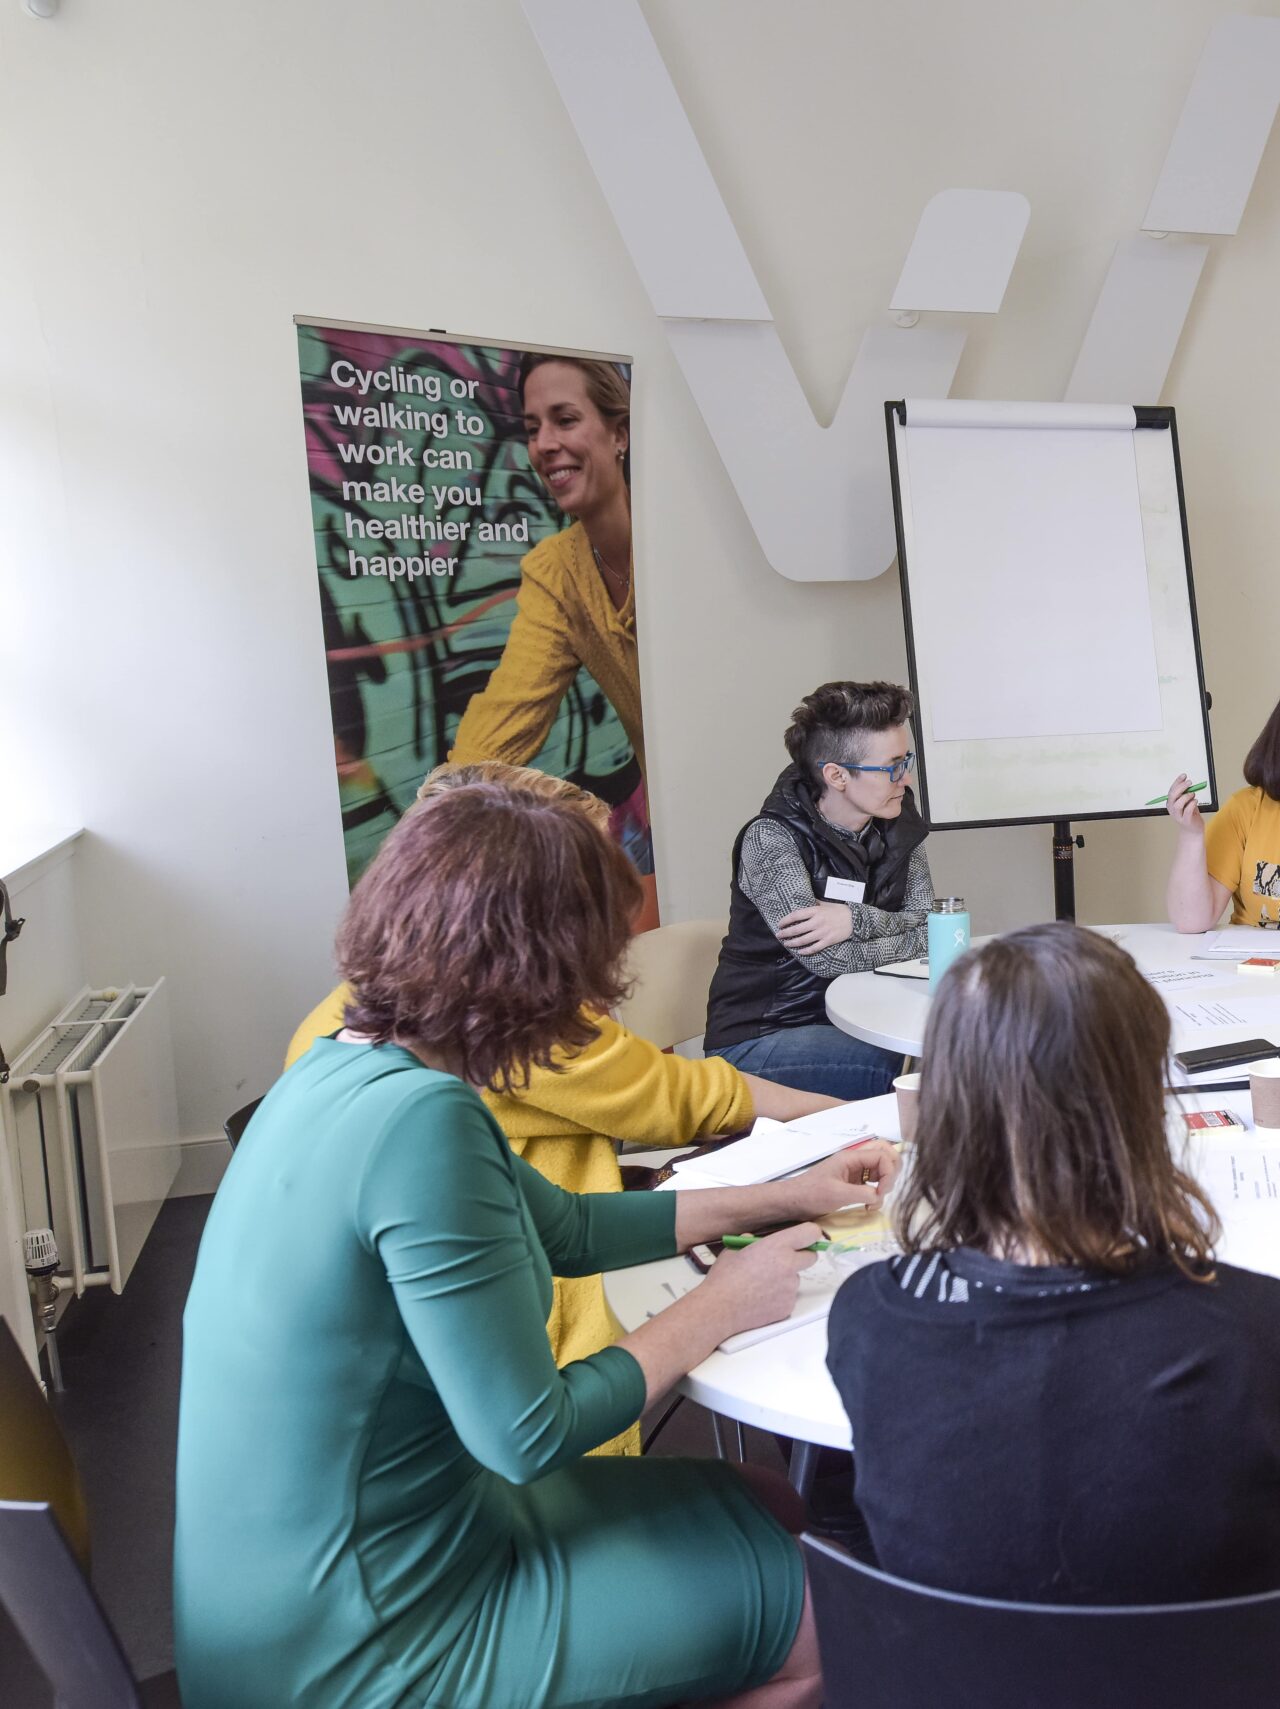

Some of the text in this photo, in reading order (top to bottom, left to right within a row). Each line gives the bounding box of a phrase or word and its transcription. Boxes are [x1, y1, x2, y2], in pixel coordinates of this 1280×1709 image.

[330, 359, 479, 401] Cycling or
[334, 402, 484, 439] walking to
[338, 440, 473, 470] work can
[342, 477, 482, 510] make you
[345, 512, 529, 543] healthier and
[348, 550, 459, 582] happier
